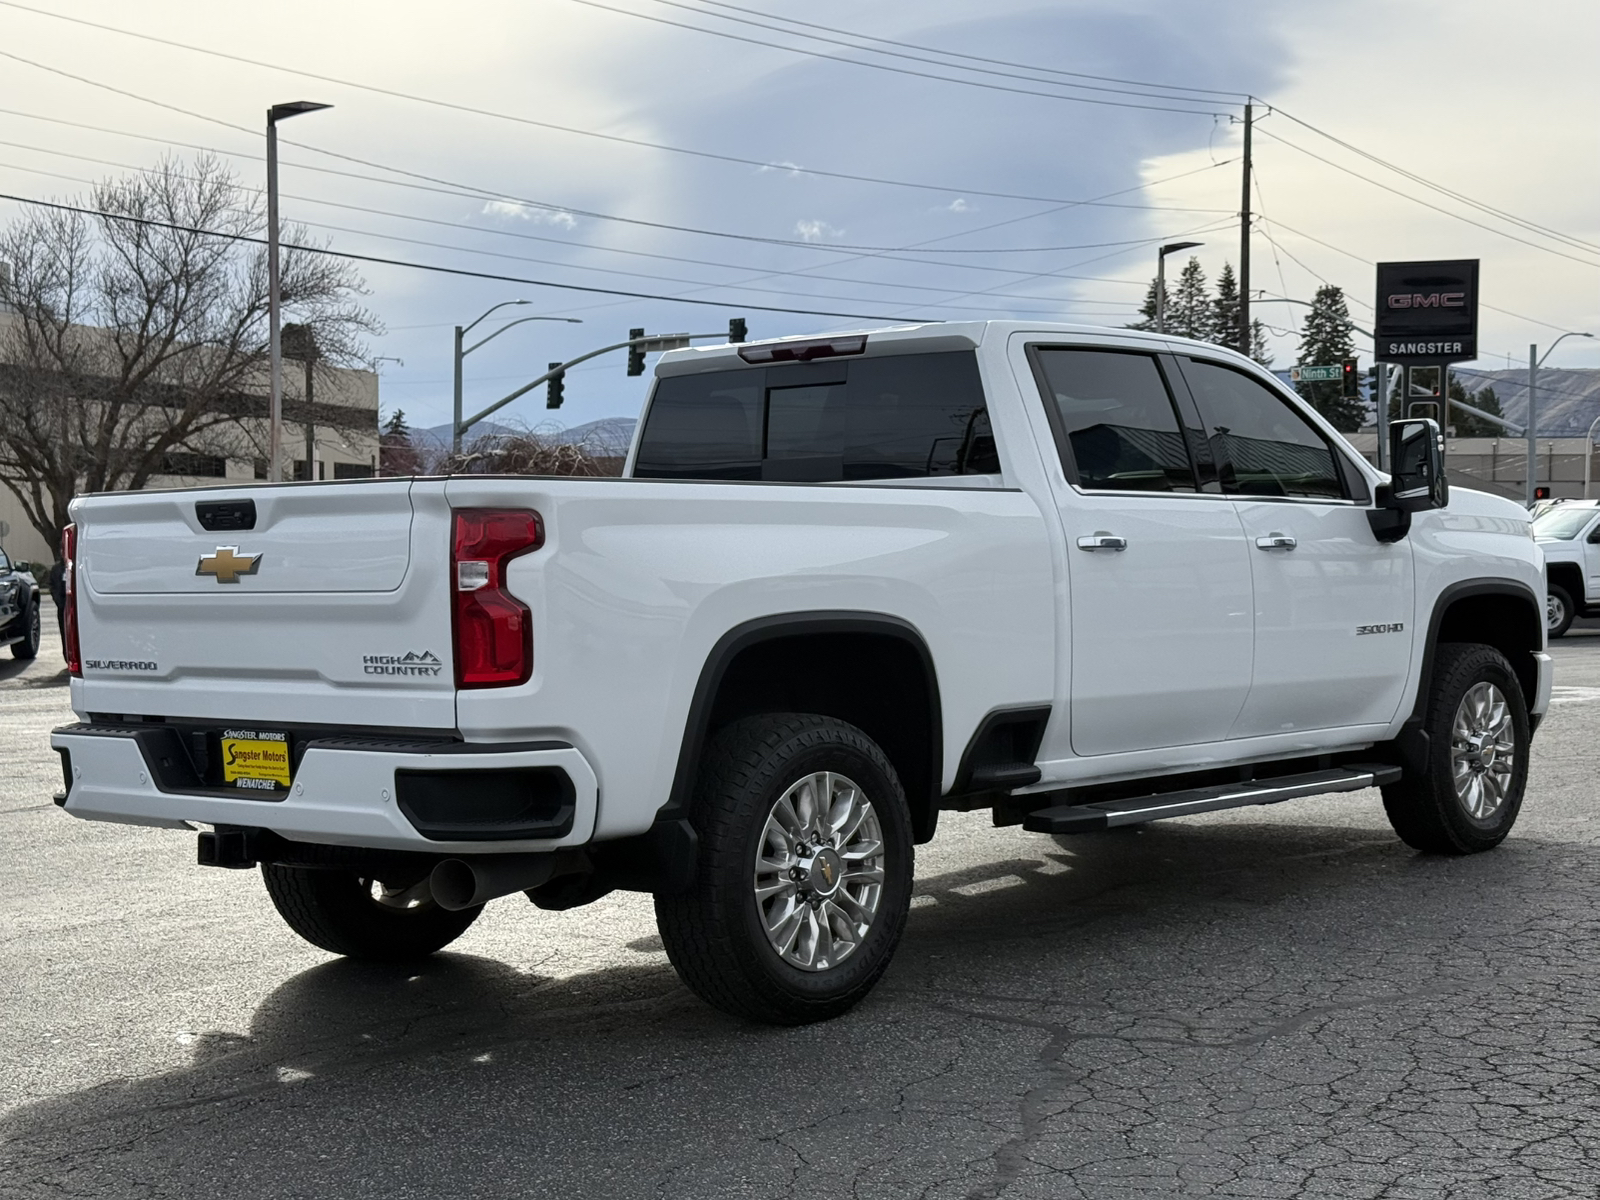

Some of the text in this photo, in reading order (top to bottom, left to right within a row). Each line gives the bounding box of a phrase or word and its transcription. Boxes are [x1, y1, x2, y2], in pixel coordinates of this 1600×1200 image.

[1388, 292, 1465, 308] GMC
[1389, 342, 1462, 354] SANGSTER
[1302, 368, 1340, 379] Ninth St
[85, 660, 158, 670] SILVERADO
[363, 656, 401, 664] HIGH
[364, 665, 442, 676] COUNTRY
[220, 729, 286, 741] SANGSTER MOTORS
[226, 743, 287, 766] Sangster Motors
[236, 777, 276, 790] WENATCHEE
